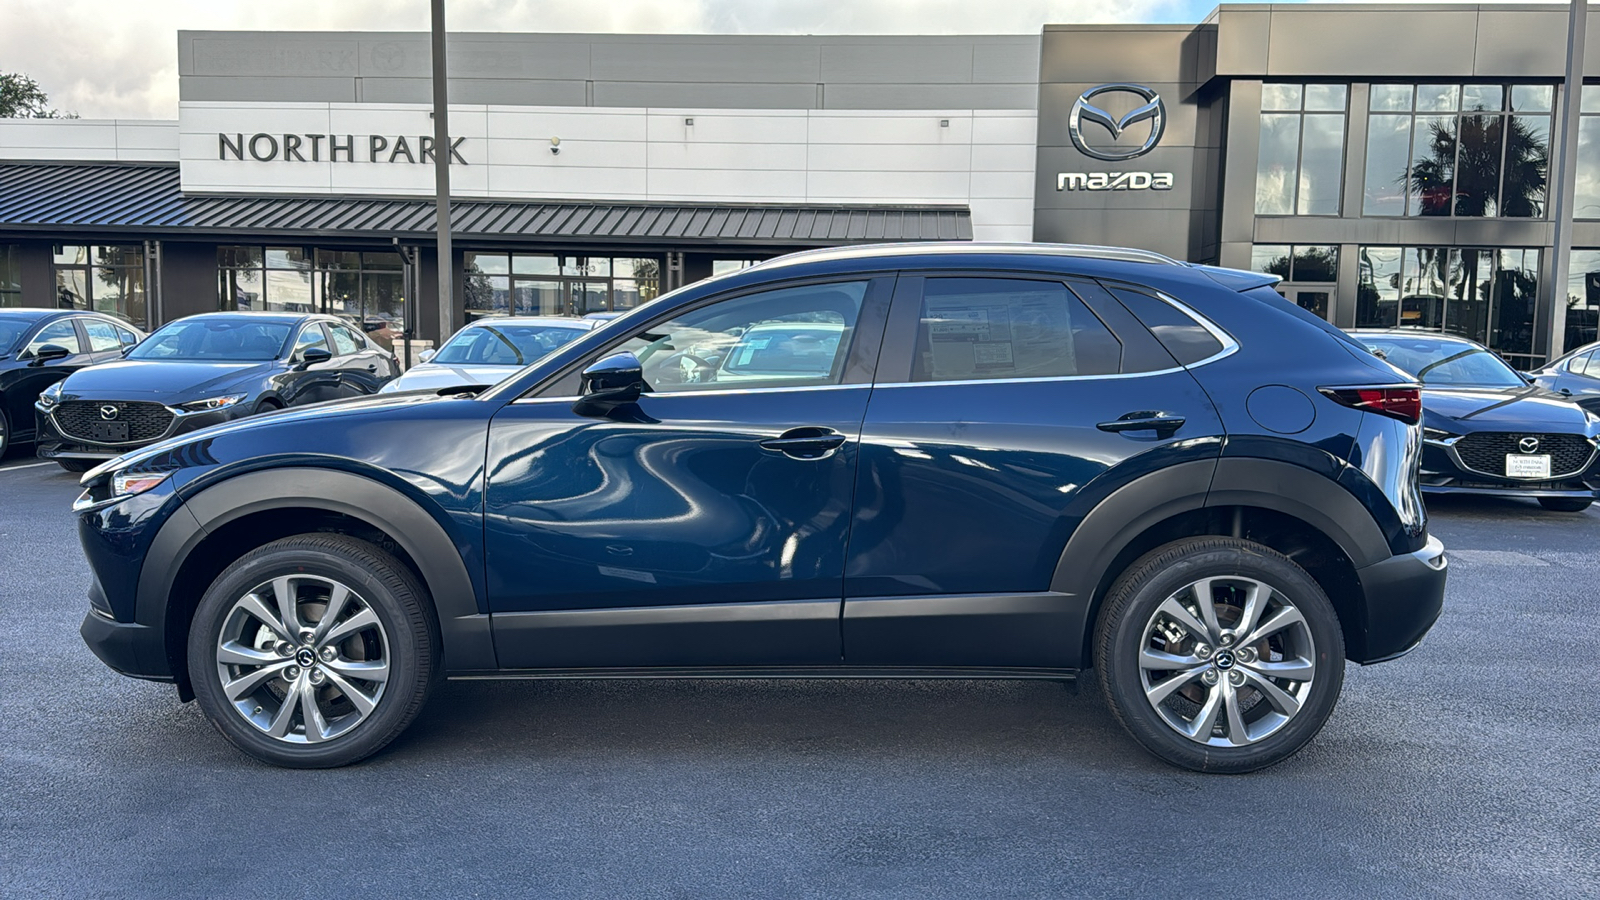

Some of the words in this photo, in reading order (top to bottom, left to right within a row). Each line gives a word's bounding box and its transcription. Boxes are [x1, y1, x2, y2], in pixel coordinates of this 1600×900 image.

[218, 132, 354, 162] NORTH
[369, 134, 468, 165] PARK
[1056, 172, 1174, 191] mazda
